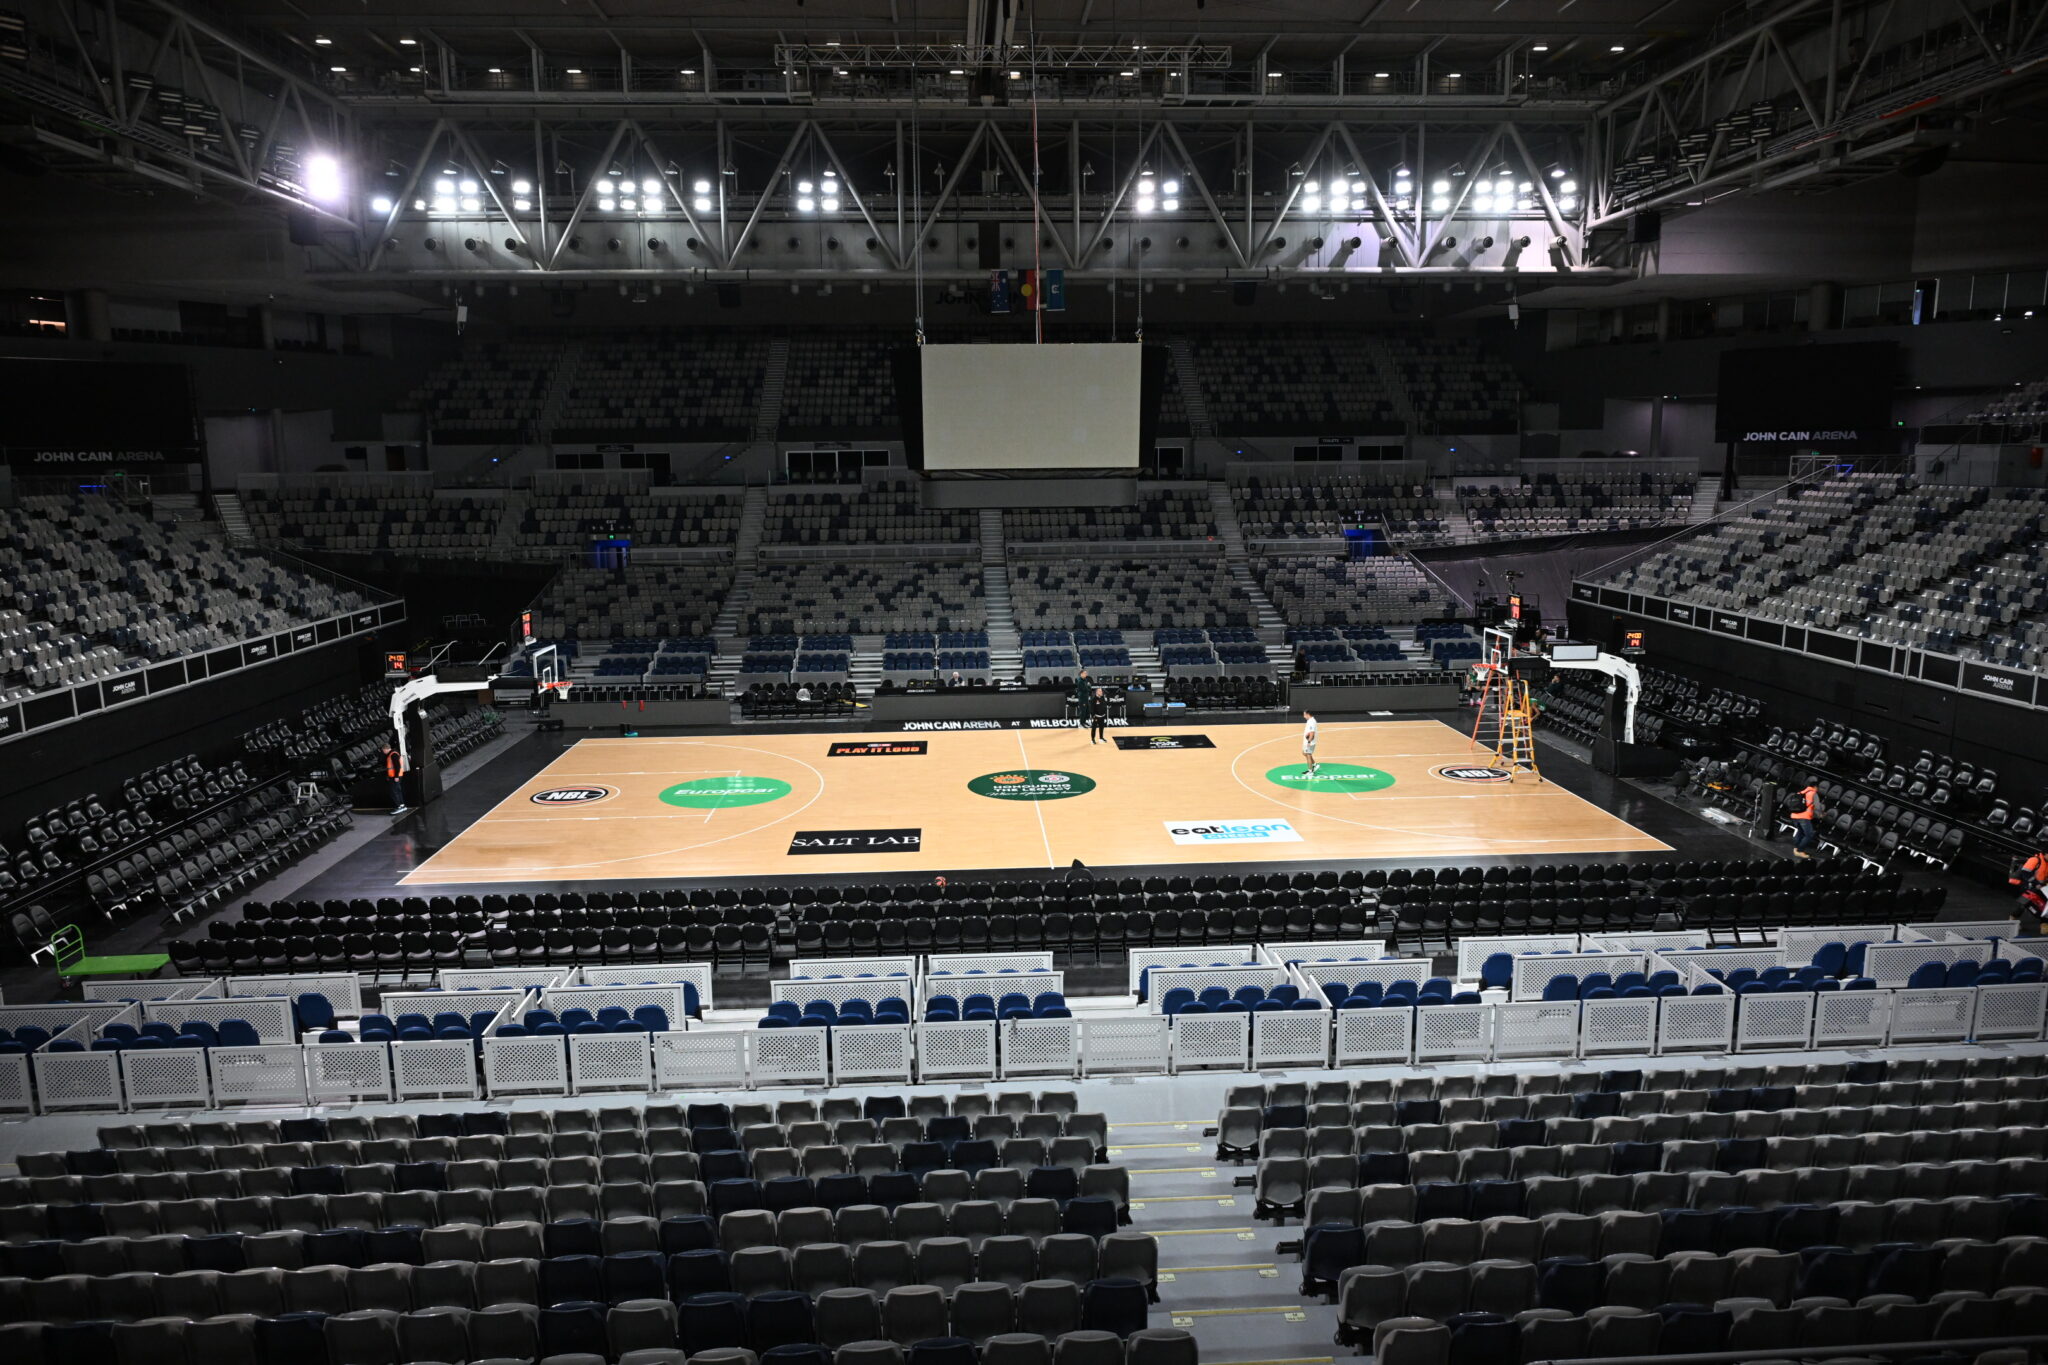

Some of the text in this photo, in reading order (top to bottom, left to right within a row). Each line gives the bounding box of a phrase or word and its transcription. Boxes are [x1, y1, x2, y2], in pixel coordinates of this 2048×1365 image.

[1742, 430, 1858, 442] JOHN CAIN ARENA
[33, 450, 165, 463] JOHN CAIN ARENA
[903, 721, 933, 731] JOHN
[933, 720, 961, 730] CAIN
[962, 720, 1001, 729] ARENA
[1280, 773, 1377, 781] Europcar
[1453, 769, 1500, 778] NBL
[546, 791, 590, 801] NBL
[673, 787, 778, 796] Europcar
[791, 836, 920, 847] SALT LAB
